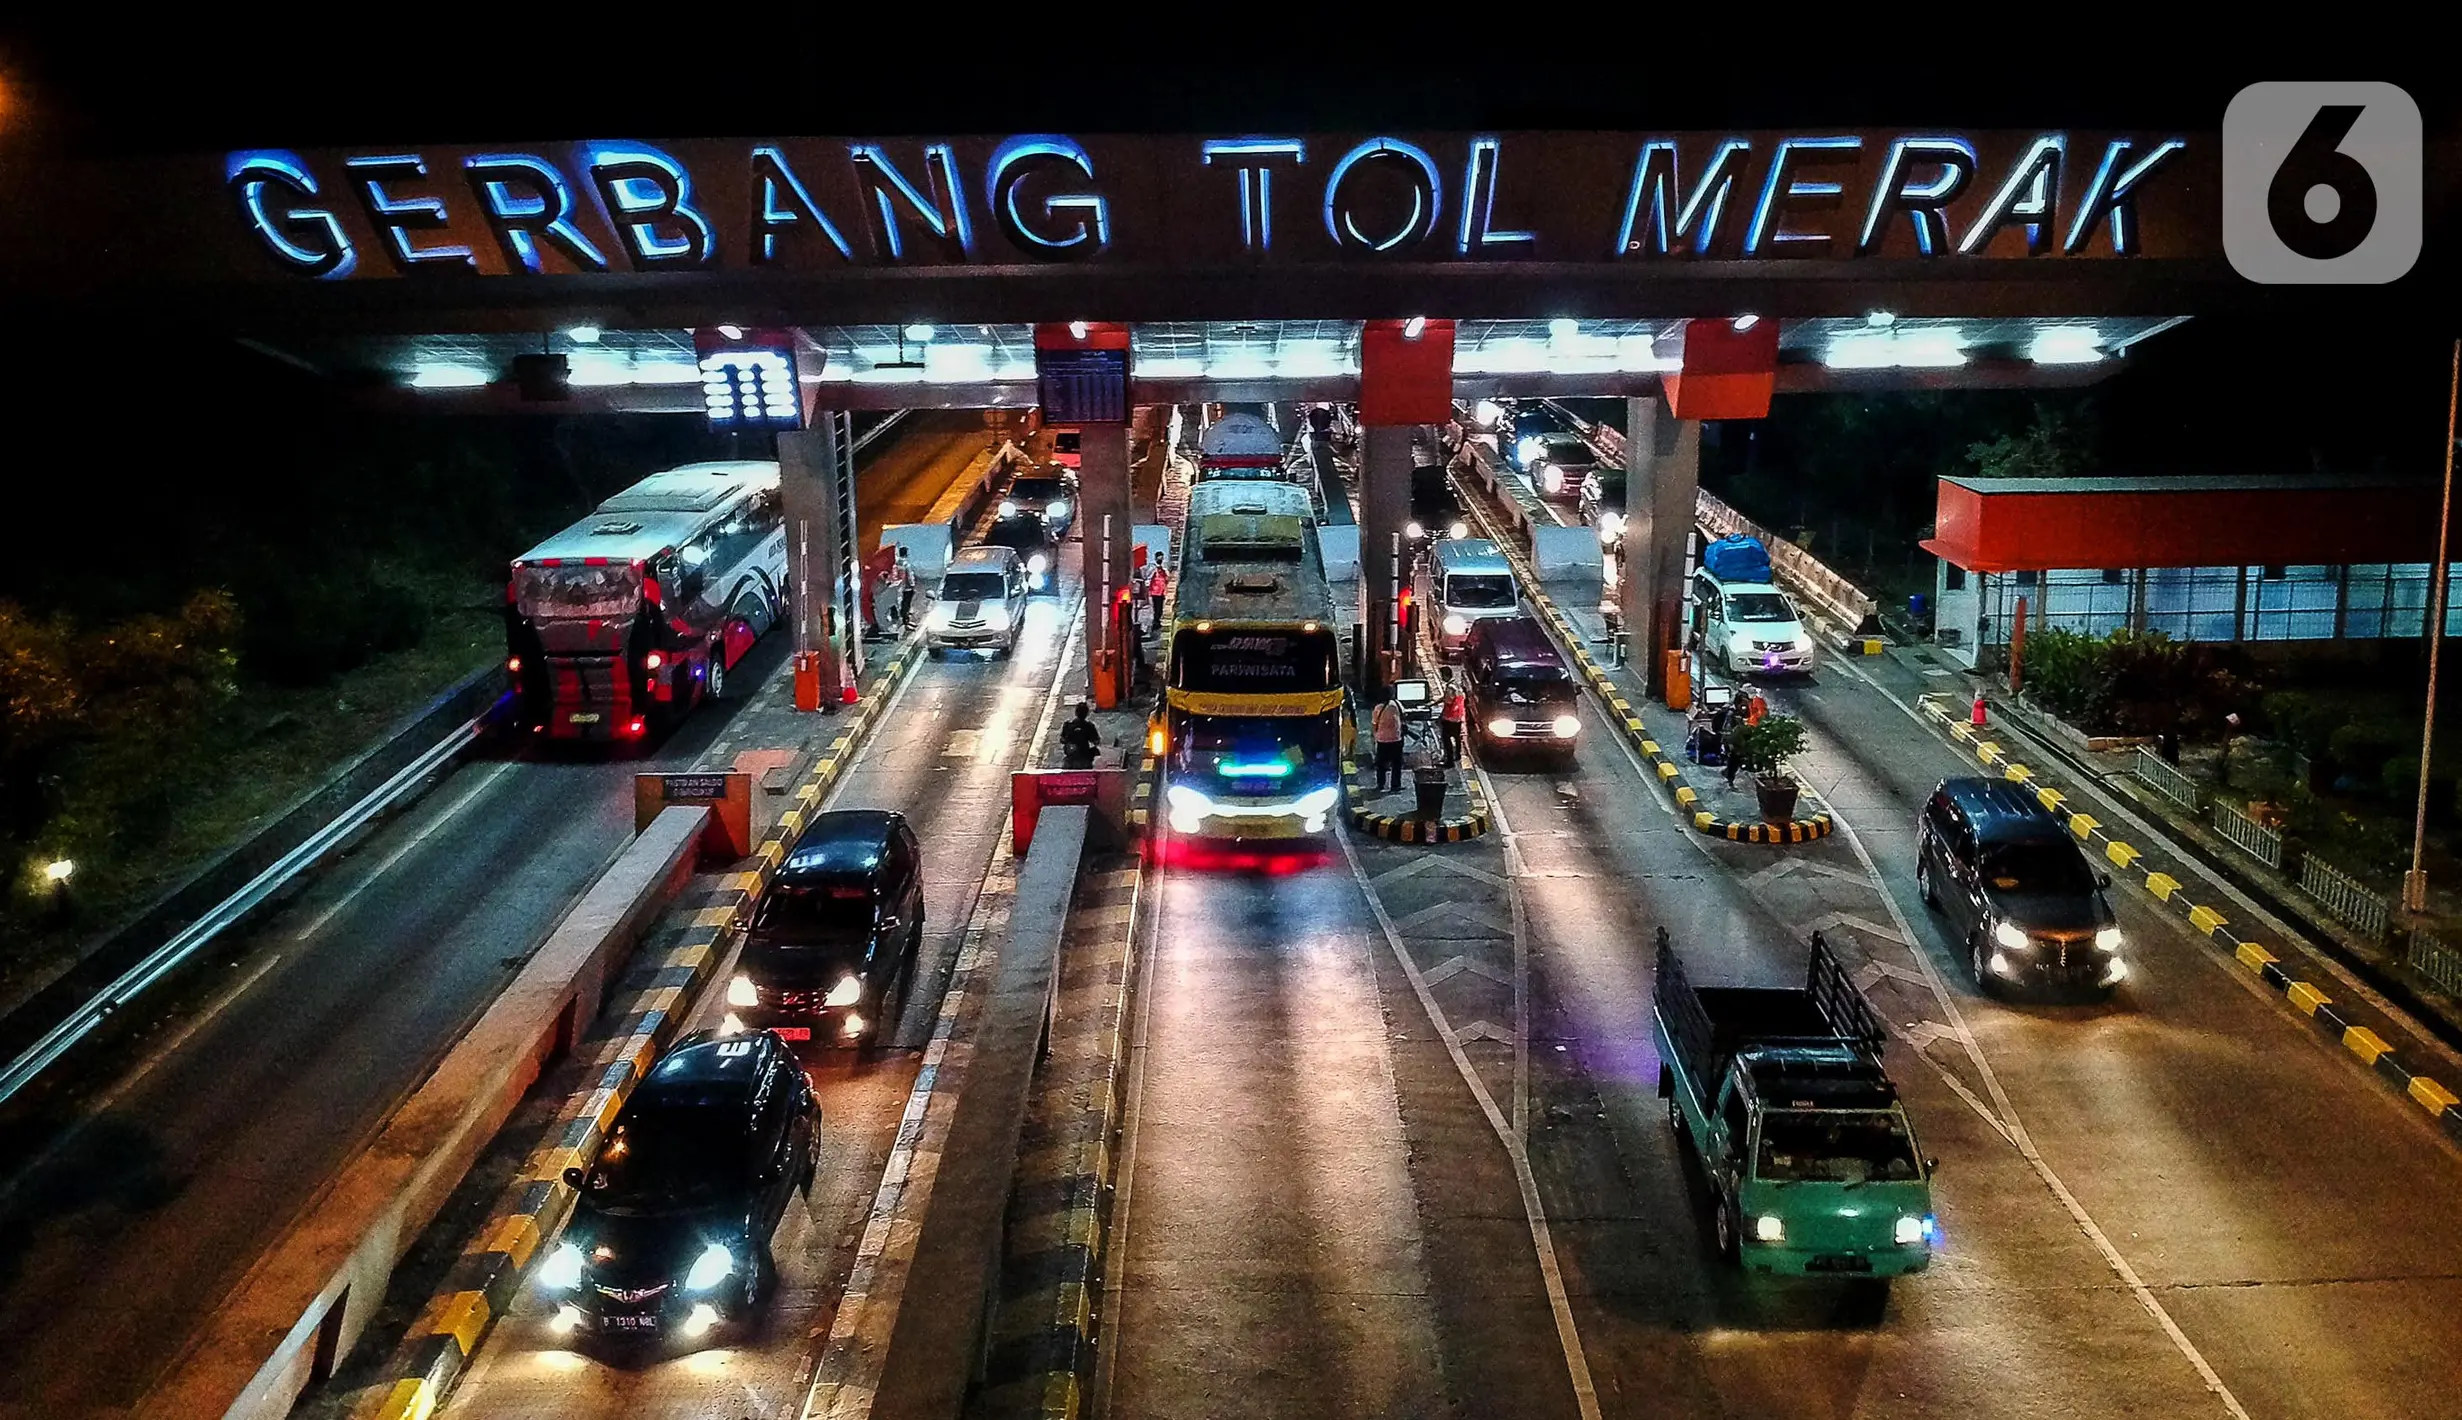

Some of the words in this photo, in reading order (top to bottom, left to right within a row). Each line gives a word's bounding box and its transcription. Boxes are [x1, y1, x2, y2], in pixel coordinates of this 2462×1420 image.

[227, 135, 1110, 278] GERBANG
[1202, 136, 1537, 256] TOL
[1615, 134, 2186, 258] MERAK
